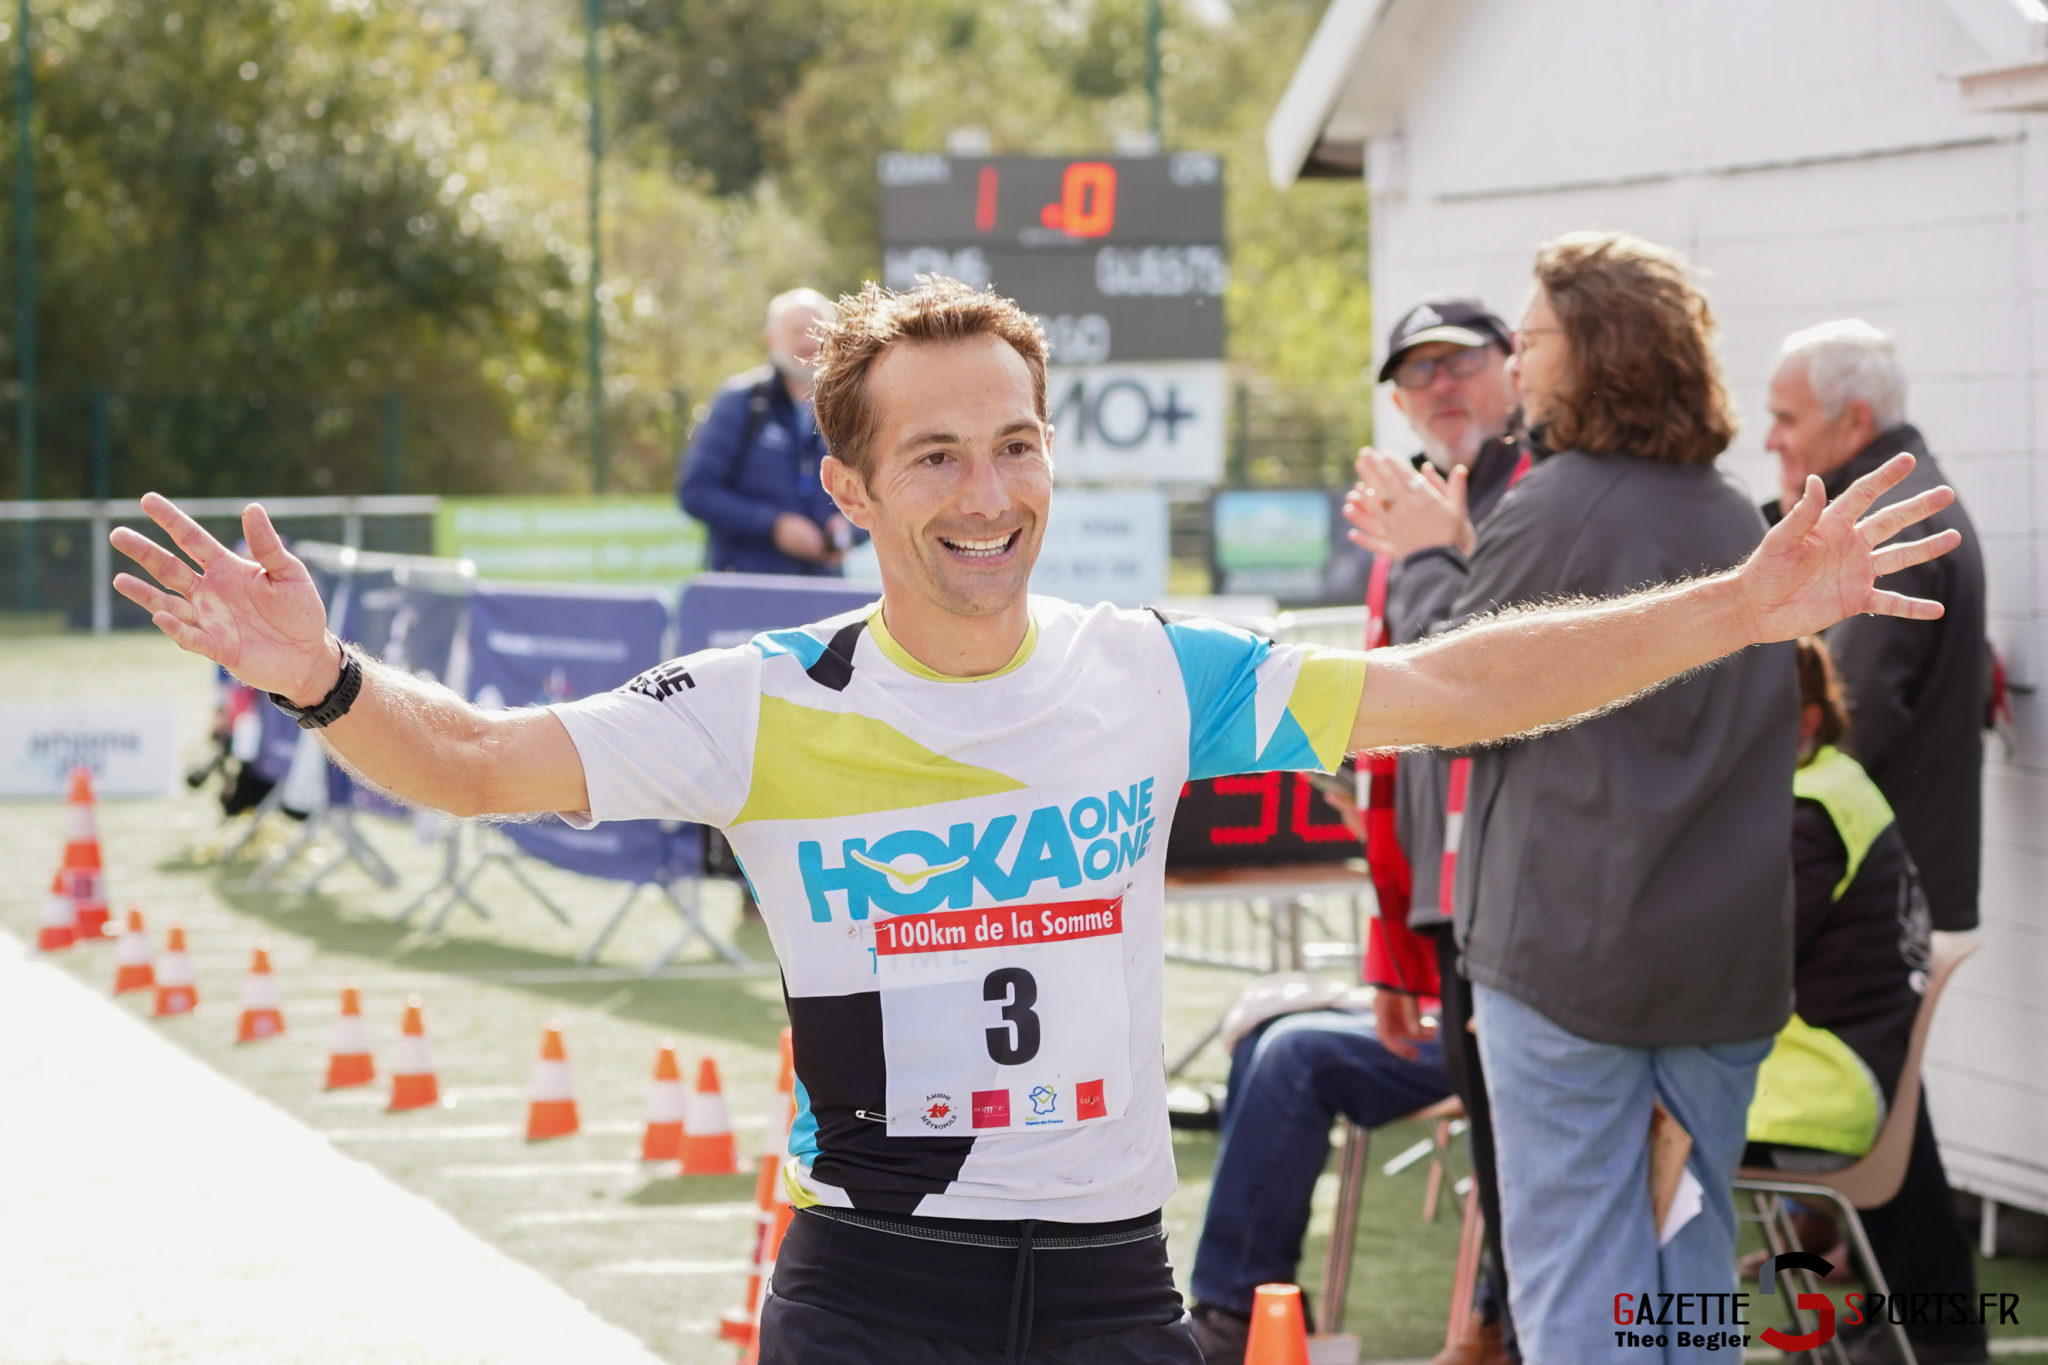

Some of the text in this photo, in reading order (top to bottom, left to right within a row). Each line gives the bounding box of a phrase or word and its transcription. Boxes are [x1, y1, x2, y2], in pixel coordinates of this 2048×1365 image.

[1070, 776, 1155, 840] ONE
[798, 805, 1083, 923] HOKA
[1082, 816, 1156, 882] ONE
[885, 909, 1114, 948] 100km de la Somme
[983, 967, 1041, 1065] 3
